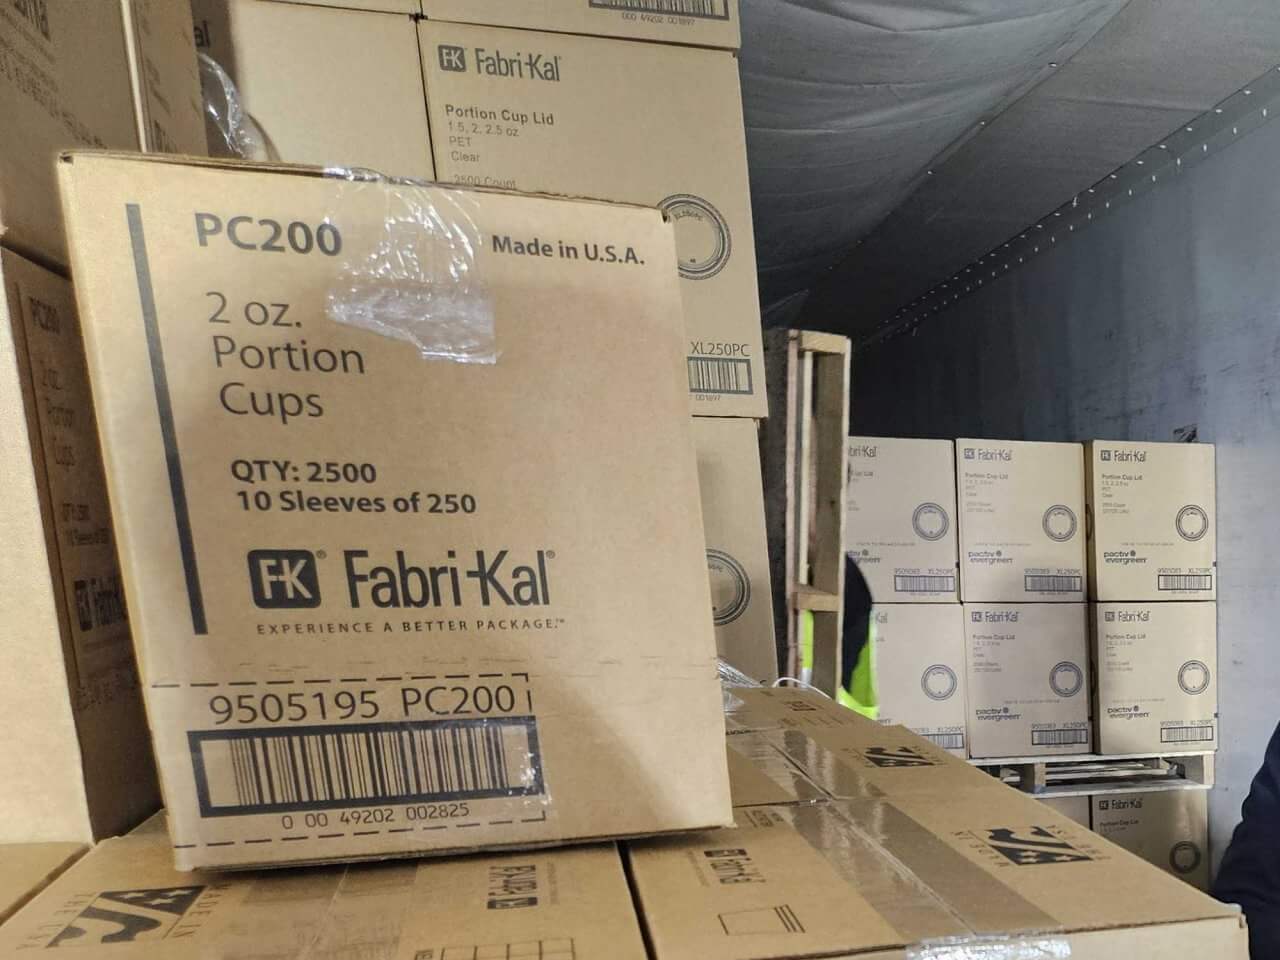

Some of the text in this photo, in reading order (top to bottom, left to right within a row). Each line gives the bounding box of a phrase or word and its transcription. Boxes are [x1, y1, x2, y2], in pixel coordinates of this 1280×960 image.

[440, 47, 560, 81] FK Fabri-Kal
[445, 104, 554, 126] Portion Cup Lid
[448, 135, 472, 147] PET
[451, 150, 480, 163] Clear
[194, 213, 342, 256] PC200
[492, 234, 645, 265] Made in U.S.A.
[205, 292, 303, 328] 2 oz.
[212, 335, 364, 374] Portion
[690, 341, 750, 357] XL250PC
[219, 381, 324, 424] Cups
[231, 459, 376, 483] QTY: 2500
[237, 490, 476, 513] 10 Sleeves of 250
[254, 549, 551, 608] FK Fabri-Kal
[256, 619, 468, 635] EXPERIENCE A BETTER
[209, 685, 515, 725] 9505195 PC200
[282, 803, 470, 829] 0 00 49202 002825
